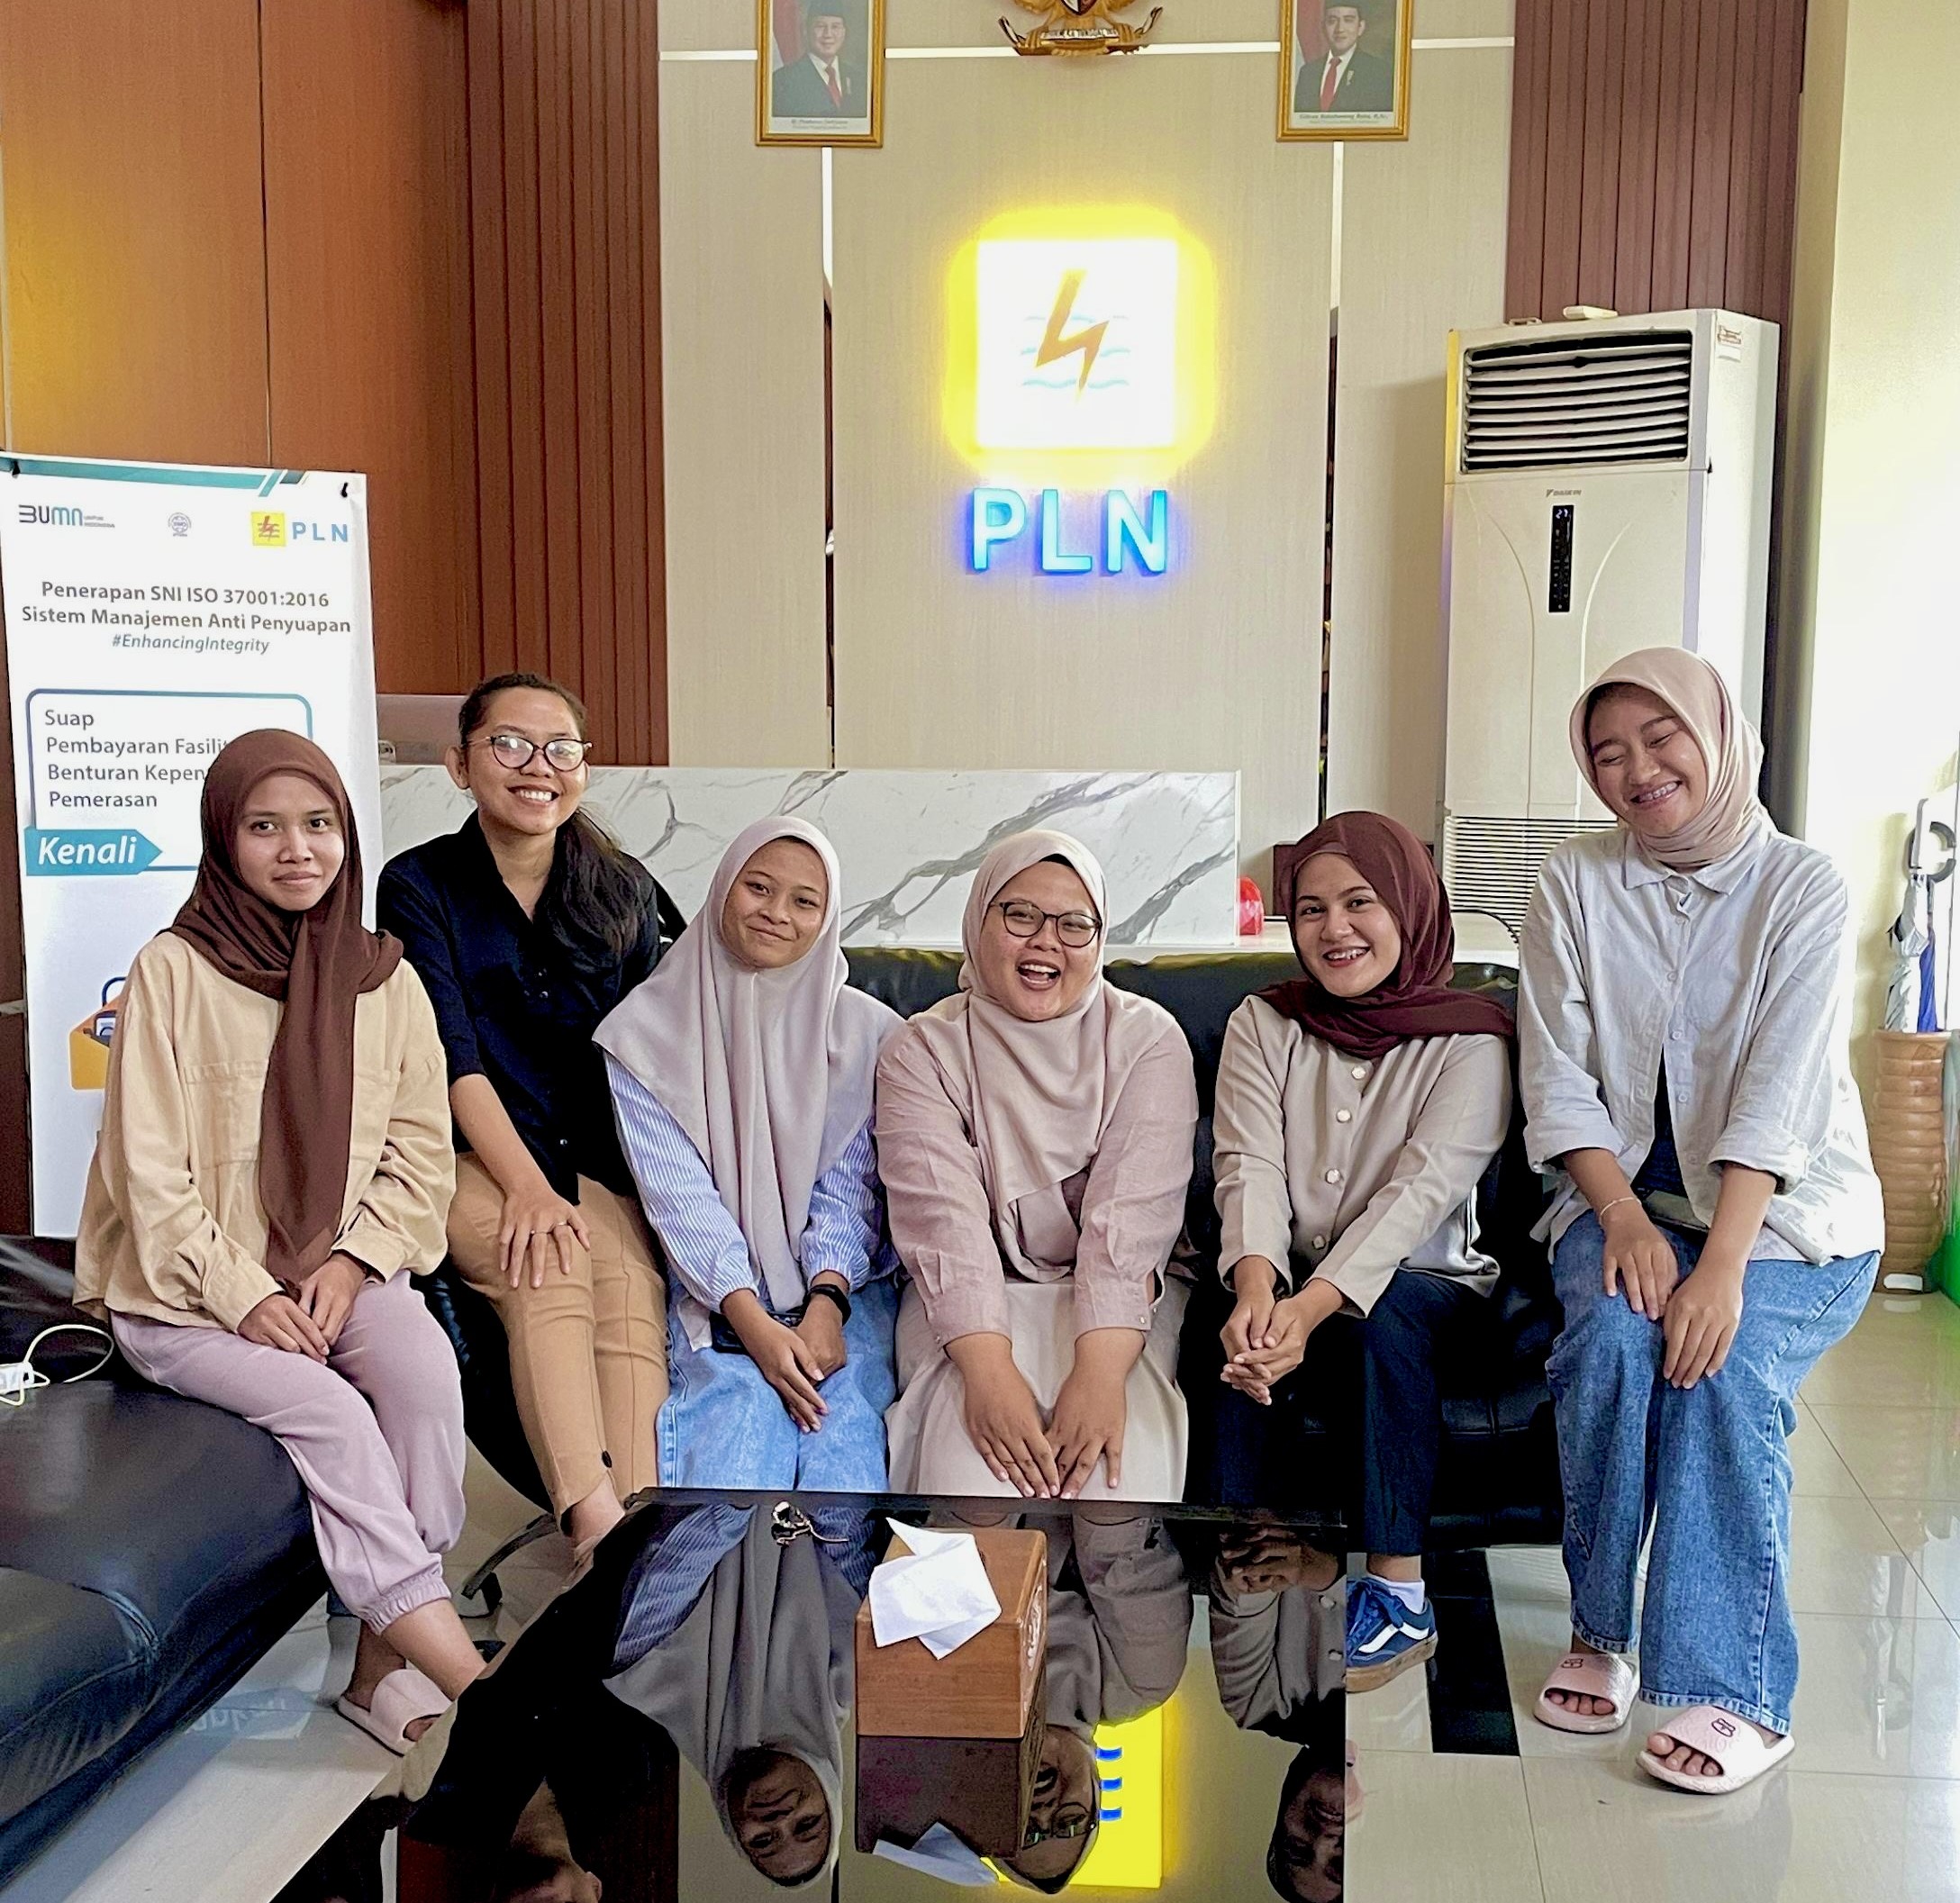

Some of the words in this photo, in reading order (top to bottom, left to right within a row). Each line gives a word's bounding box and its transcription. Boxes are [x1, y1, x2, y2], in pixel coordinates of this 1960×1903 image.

[293, 522, 348, 542] PLN
[972, 487, 1168, 573] PLN
[42, 582, 145, 603] Penerapan
[151, 586, 181, 602] SNI
[187, 587, 218, 603] ISO
[223, 590, 329, 607] 37001:2016
[23, 606, 85, 623] Sistem
[92, 609, 202, 630] Manajemen
[208, 613, 245, 629] Anti
[251, 615, 350, 635] Penyuapan
[113, 634, 269, 655] #EnhancingIntegrity
[45, 710, 94, 730] Suap
[47, 737, 168, 757] Pembayaran
[176, 739, 228, 755] Fasili
[49, 764, 139, 780] Benturan
[146, 765, 204, 785] Kepen
[50, 792, 157, 807] Pemerasan
[39, 836, 136, 865] Kenali
